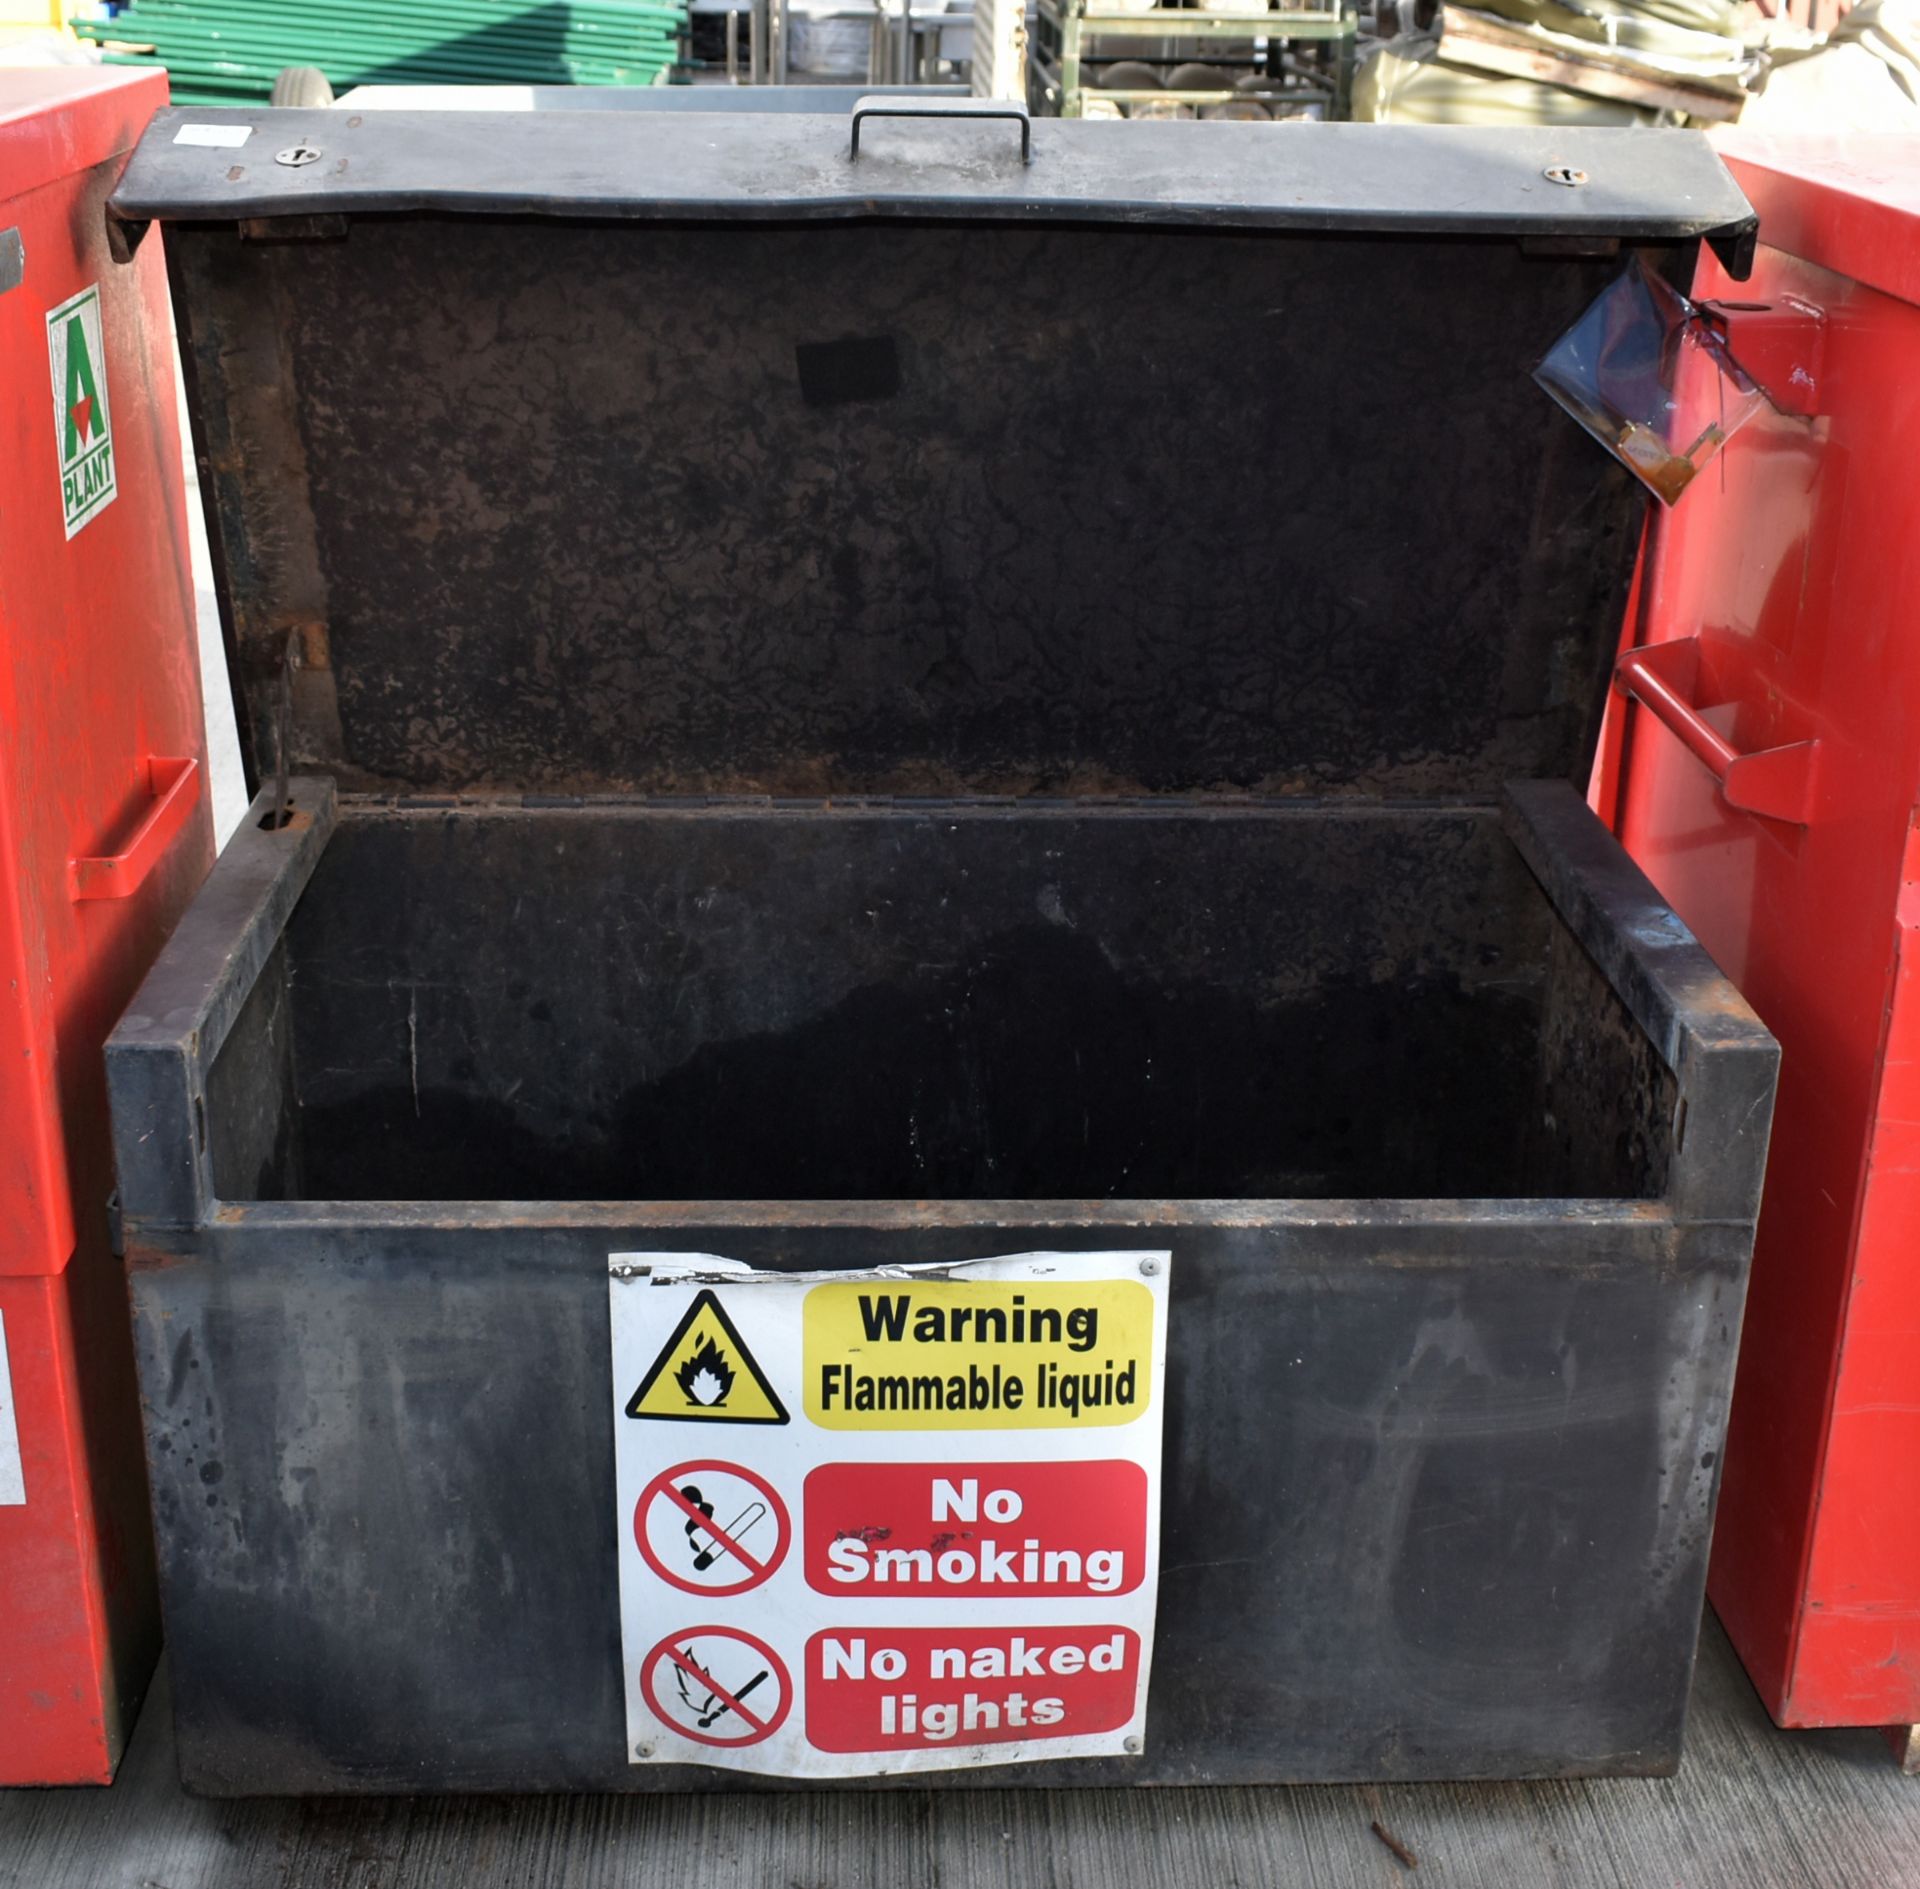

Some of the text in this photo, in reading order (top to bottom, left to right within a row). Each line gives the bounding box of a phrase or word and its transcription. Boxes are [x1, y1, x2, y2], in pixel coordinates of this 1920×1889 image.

[65, 314, 105, 464] A
[63, 445, 111, 517] PLANT
[858, 1294, 1099, 1352] Warning
[821, 1359, 1136, 1418] Flammable liquid
[930, 1478, 1023, 1523] No
[826, 1537, 1124, 1592] Smoking
[821, 1634, 1126, 1681] No naked
[880, 1690, 1065, 1738] lights
